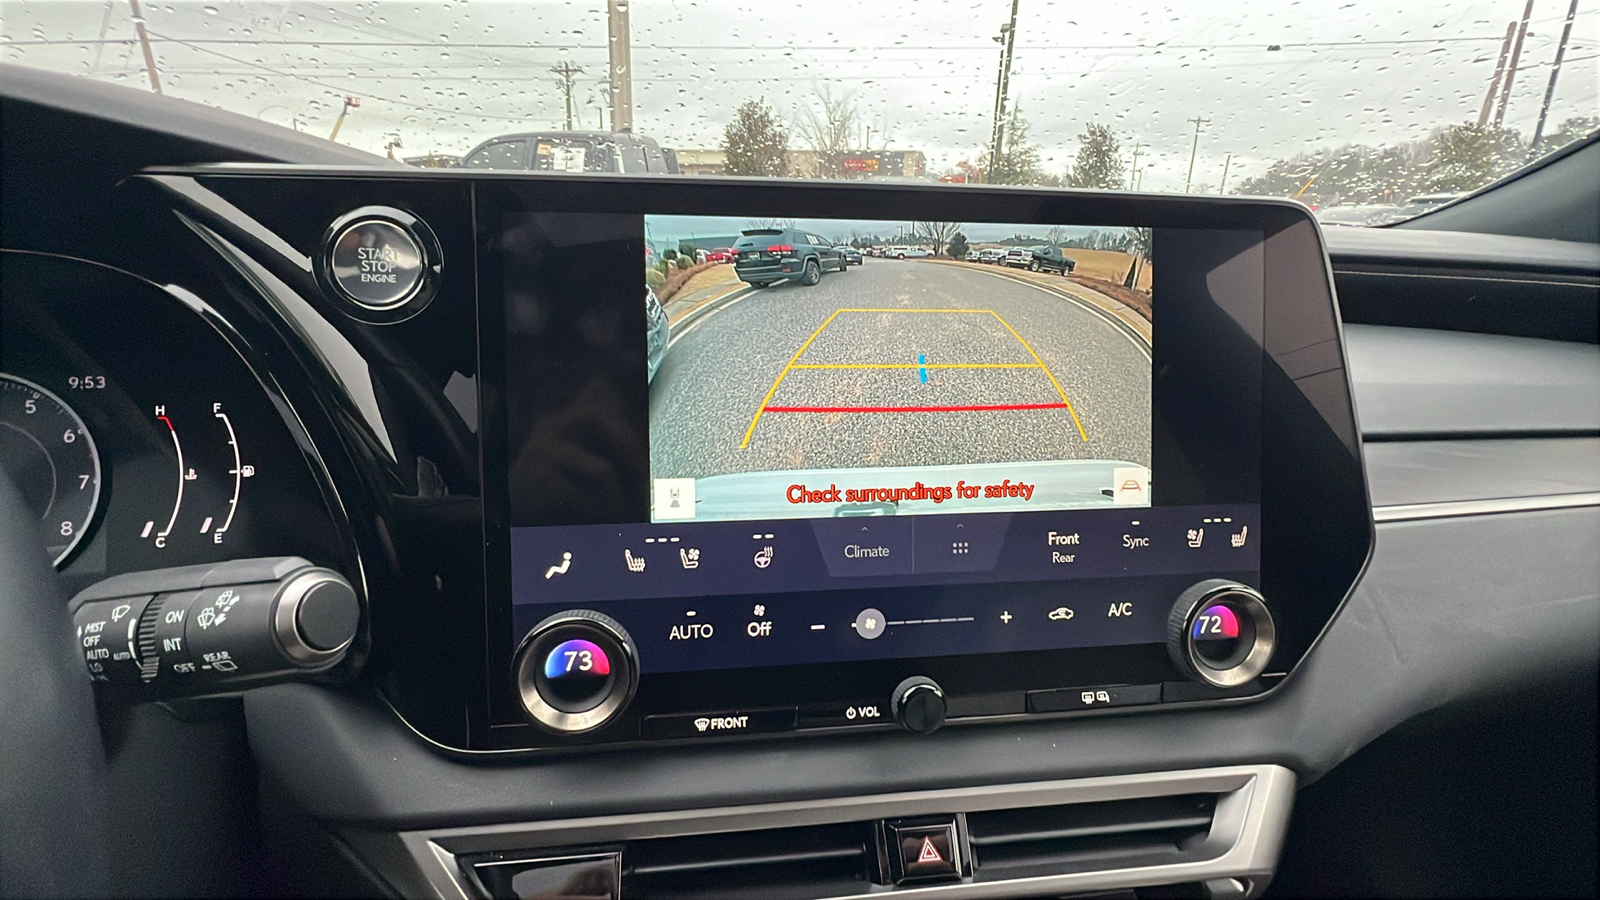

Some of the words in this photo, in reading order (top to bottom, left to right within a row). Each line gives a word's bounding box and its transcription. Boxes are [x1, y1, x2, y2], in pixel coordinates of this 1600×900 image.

[357, 247, 398, 260] START
[361, 260, 397, 273] STOP
[361, 273, 397, 283] ENGINE
[68, 376, 106, 389] 9:53
[25, 400, 36, 414] 5
[155, 405, 165, 415] H
[213, 403, 221, 413] F
[63, 429, 75, 443] 6
[78, 474, 89, 490] 7
[786, 484, 842, 504] Check
[845, 482, 952, 503] surroundings
[956, 481, 981, 498] for
[984, 479, 1035, 501] safety
[60, 521, 73, 536] 8
[155, 537, 165, 548] C
[214, 532, 223, 544] E
[1048, 531, 1080, 546] Front
[1122, 534, 1150, 549] Sync
[844, 544, 890, 558] Climate
[1052, 551, 1076, 564] Rear
[1107, 602, 1133, 618] A/C
[165, 610, 185, 624] ON
[85, 621, 106, 634] MIST
[747, 621, 773, 637] Off
[1199, 615, 1222, 634] 72
[669, 624, 714, 641] AUTO
[83, 635, 100, 647] OFF
[163, 637, 182, 652] INT
[87, 648, 109, 660] AUTO
[113, 652, 130, 660] AUTO
[203, 651, 231, 662] REAR
[173, 663, 196, 673] OFF
[564, 651, 593, 672] 73
[858, 706, 881, 719] VOL
[710, 716, 748, 730] FRONT
